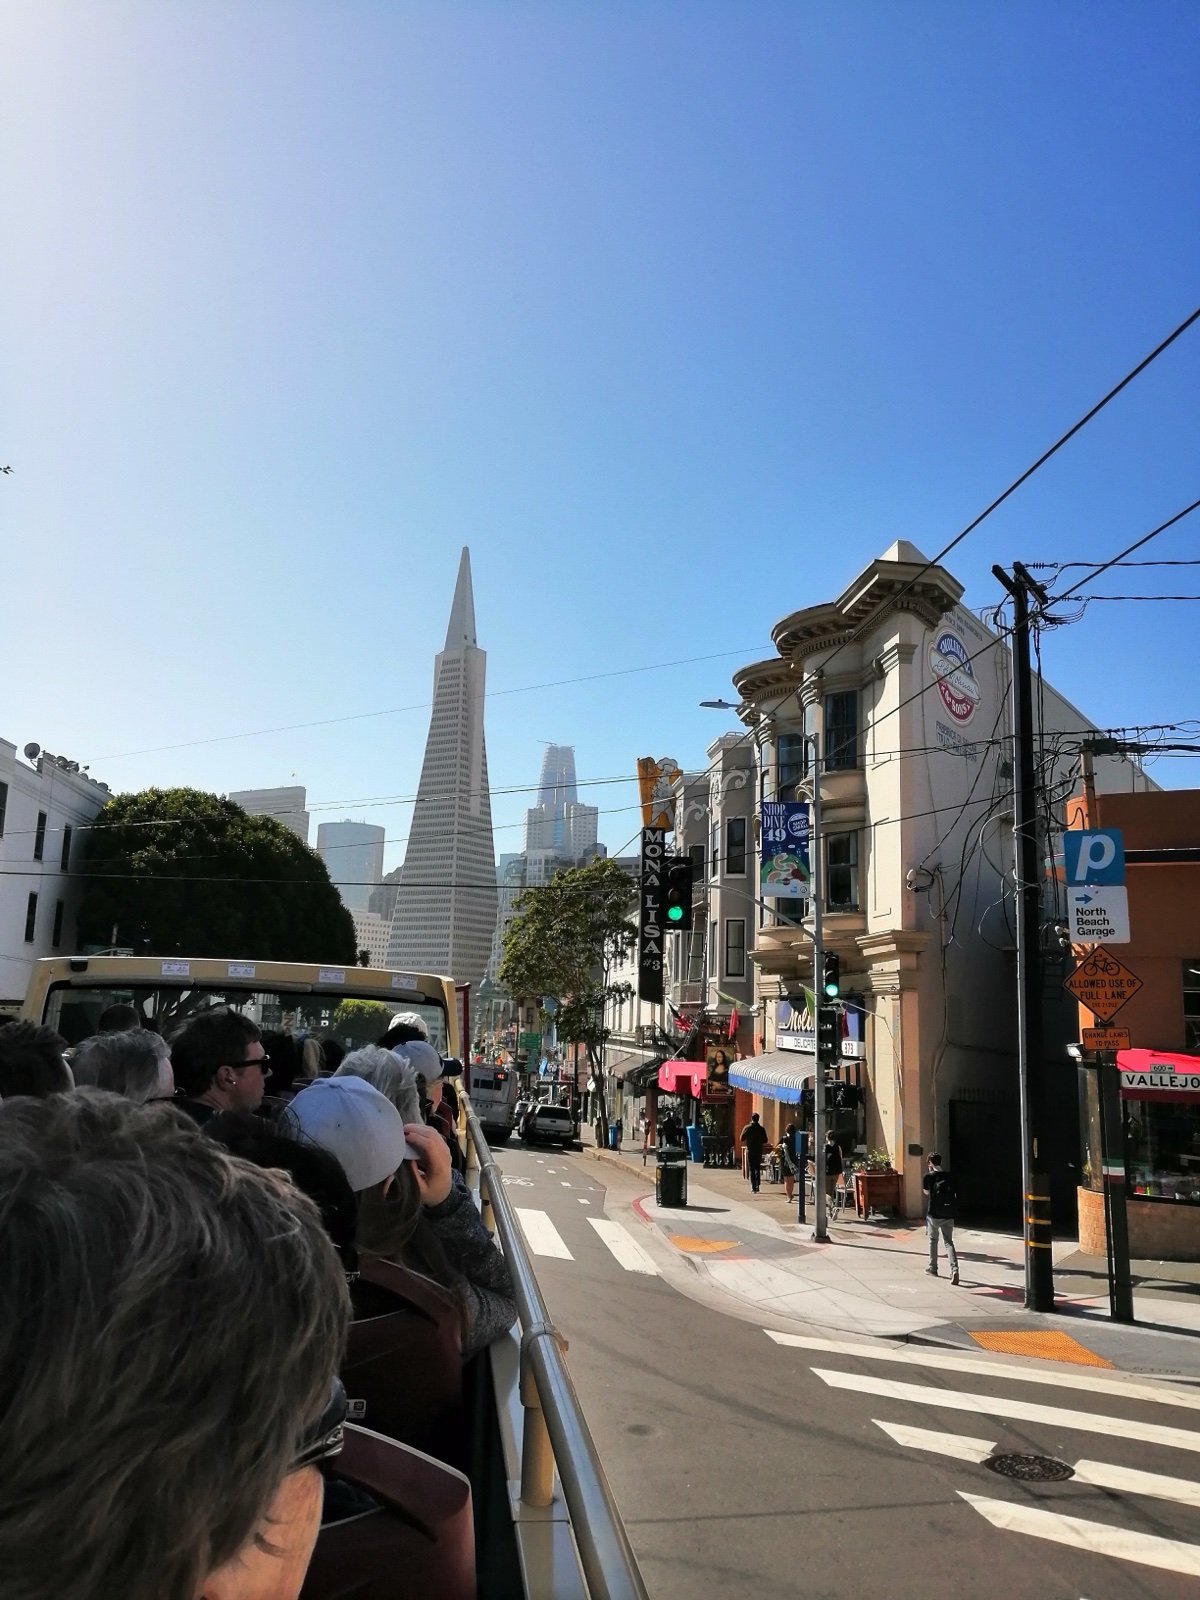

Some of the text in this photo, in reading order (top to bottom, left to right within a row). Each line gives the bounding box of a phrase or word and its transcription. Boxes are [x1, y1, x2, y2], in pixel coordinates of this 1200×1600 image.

[763, 803, 786, 816] SHOP
[763, 815, 786, 828] DINE
[763, 828, 787, 842] 49
[642, 829, 663, 971] MONA LISA #3
[1076, 907, 1106, 916] North
[1076, 917, 1110, 926] Beach
[1077, 927, 1116, 937] Garage
[1069, 979, 1137, 989] ALLOWED USE OF
[1080, 990, 1127, 1000] FULL LANE
[844, 1042, 854, 1055] 373
[1125, 1074, 1200, 1089] VALLEJO
